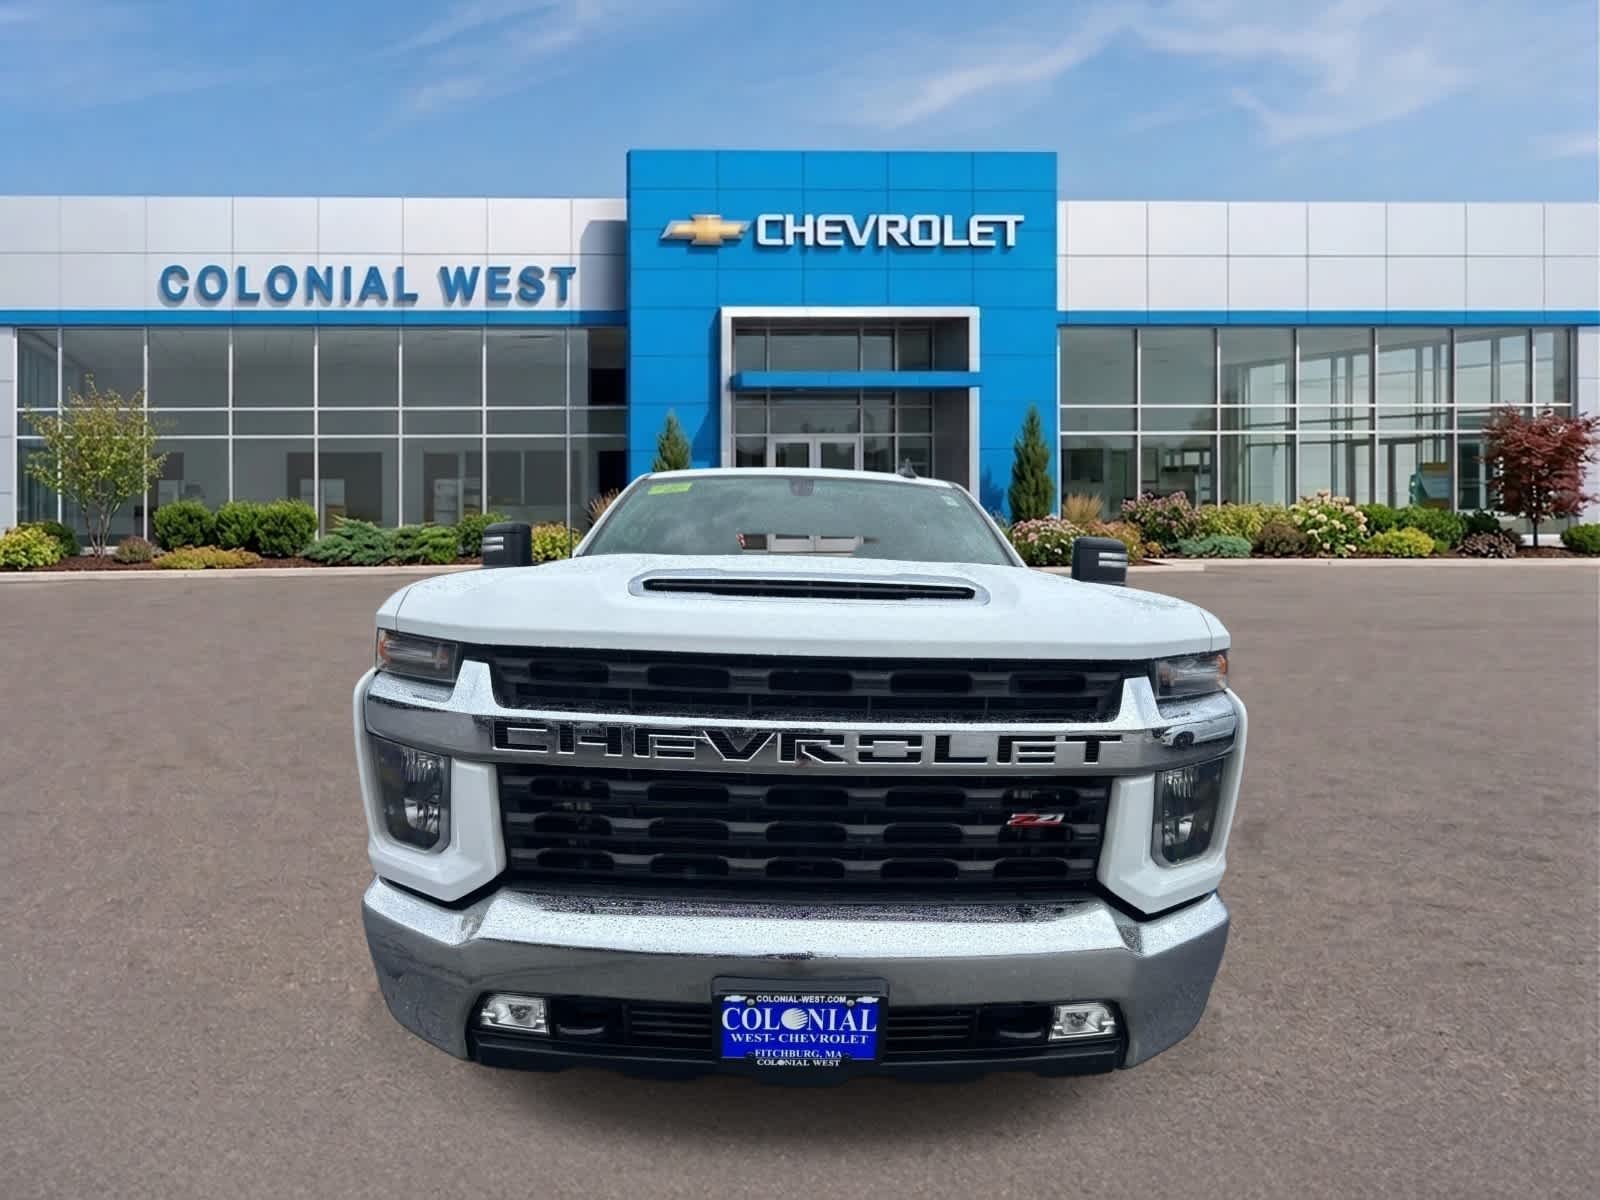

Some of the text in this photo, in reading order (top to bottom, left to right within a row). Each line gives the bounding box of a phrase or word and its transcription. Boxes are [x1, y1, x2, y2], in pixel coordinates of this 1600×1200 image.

[757, 214, 1024, 246] CHEVROLET
[160, 265, 576, 303] COLONIAL WEST
[492, 721, 1123, 765] CHEVROLET
[756, 995, 847, 1004] COLONIAL-WEST.COM
[722, 1007, 877, 1032] COLONIAL
[778, 1034, 869, 1044] CHEVROLET
[825, 1050, 842, 1058] MA
[813, 1059, 841, 1067] WEST
